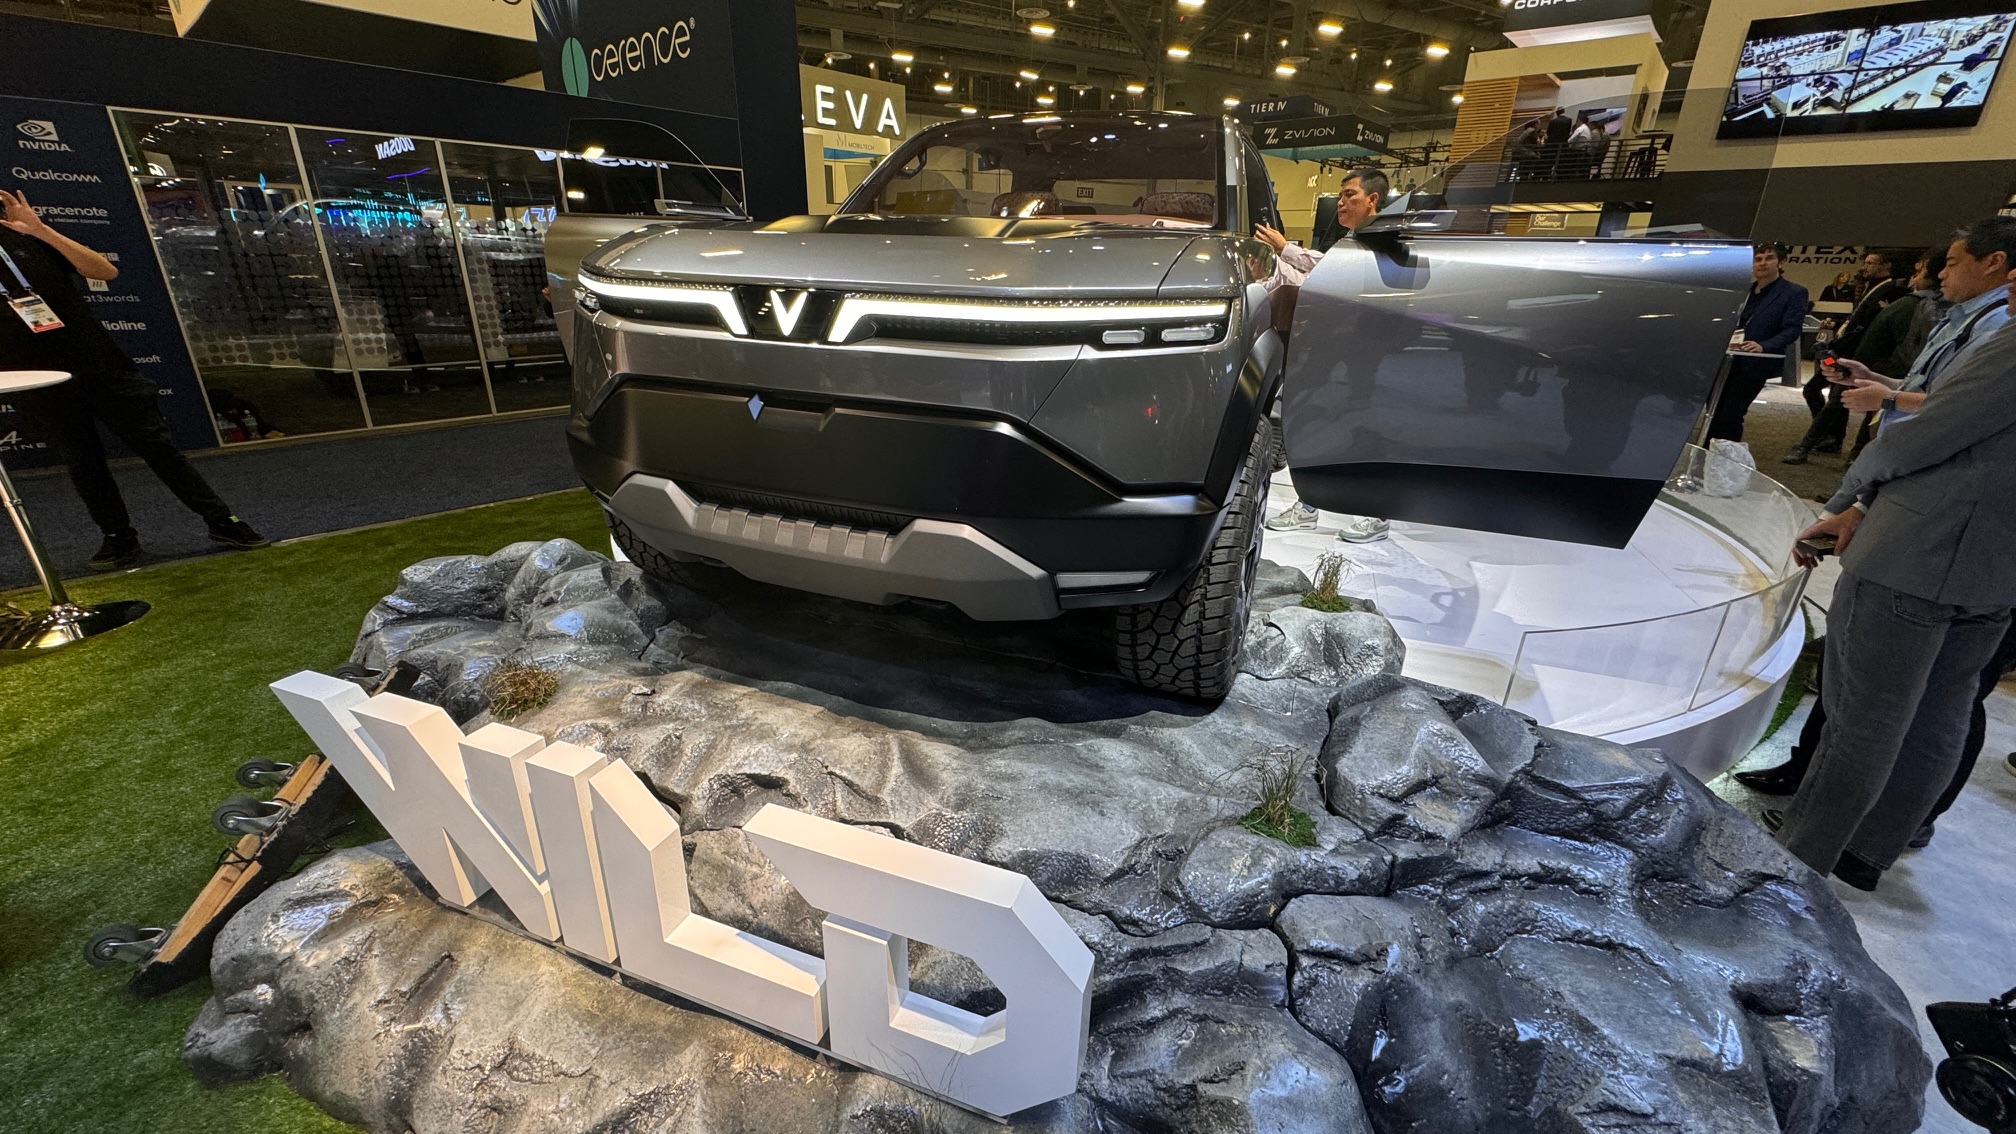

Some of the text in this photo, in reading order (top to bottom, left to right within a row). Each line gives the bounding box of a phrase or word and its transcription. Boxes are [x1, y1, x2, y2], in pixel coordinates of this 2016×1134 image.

[801, 84, 901, 136] EVA
[1250, 102, 1275, 114] TIER
[1313, 102, 1325, 115] TIER
[1284, 127, 1336, 140] ZVISION
[12, 166, 102, 183] Qualcomm
[31, 205, 108, 217] gracenote
[270, 670, 1094, 1117] WILD
